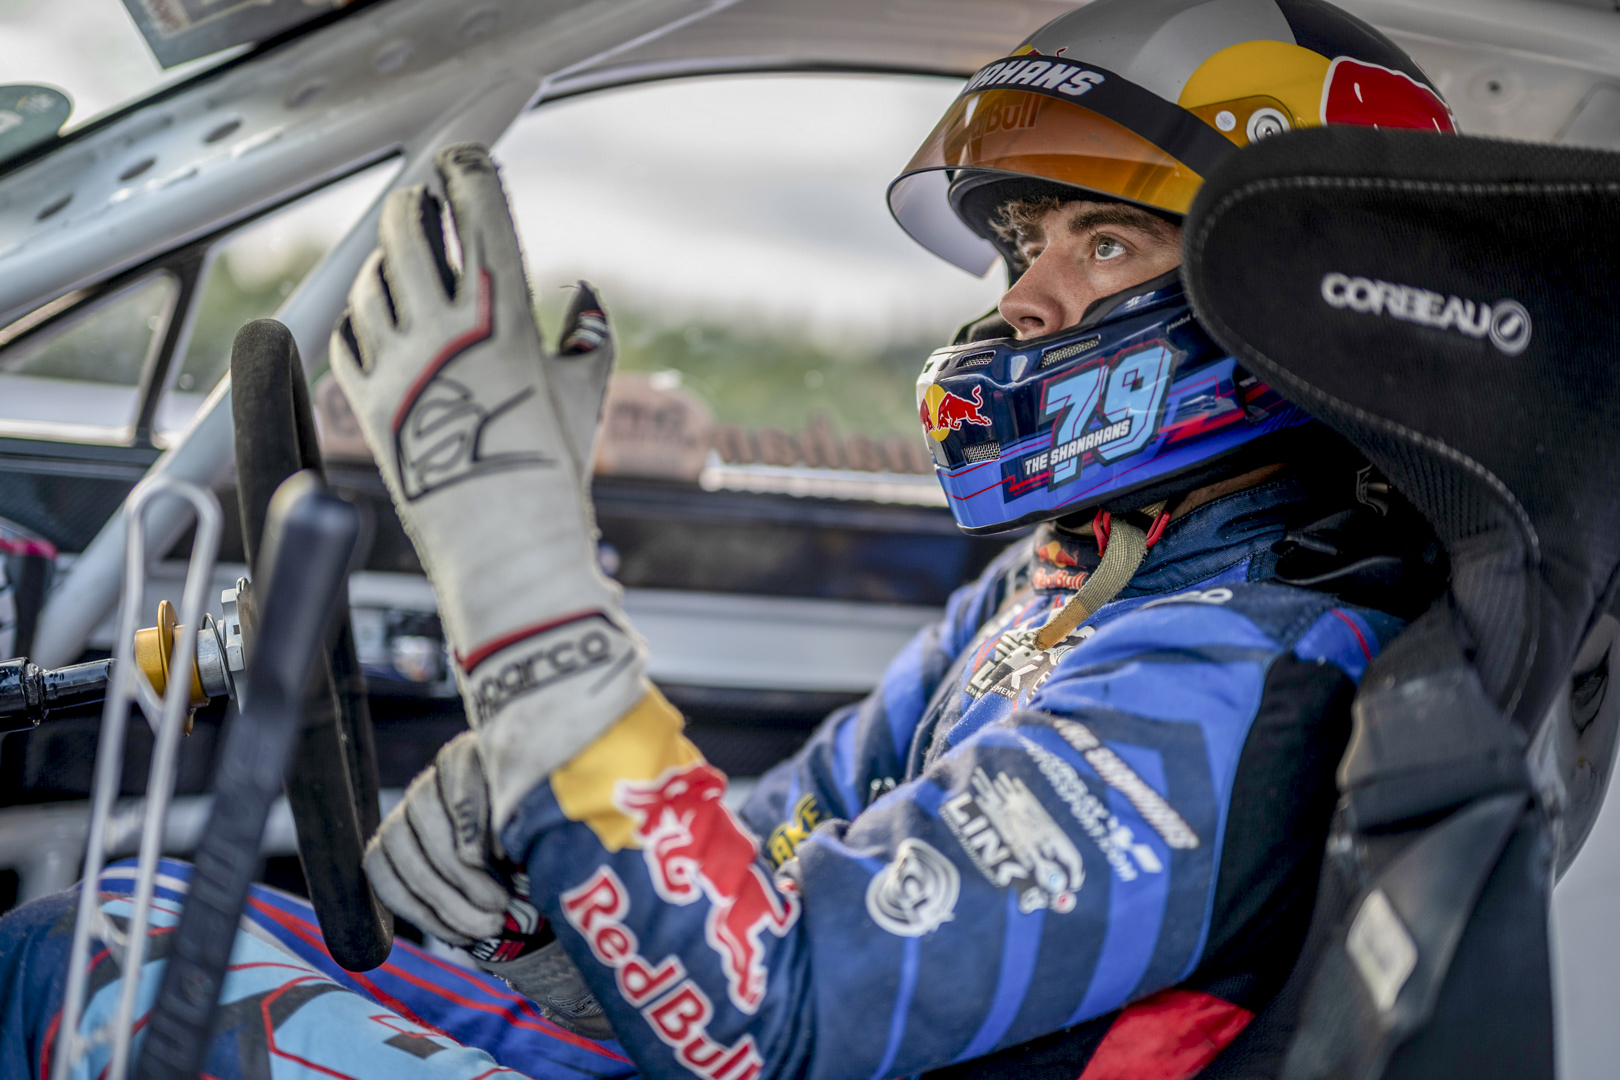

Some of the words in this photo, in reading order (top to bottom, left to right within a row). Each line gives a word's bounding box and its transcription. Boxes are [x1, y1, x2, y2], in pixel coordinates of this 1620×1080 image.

[1321, 272, 1491, 339] CORBEAU
[1024, 453, 1048, 476] THE
[1050, 420, 1131, 466] SHANAHANS
[1042, 342, 1174, 487] 79
[560, 864, 688, 1008] Red
[640, 978, 765, 1080] Bull
